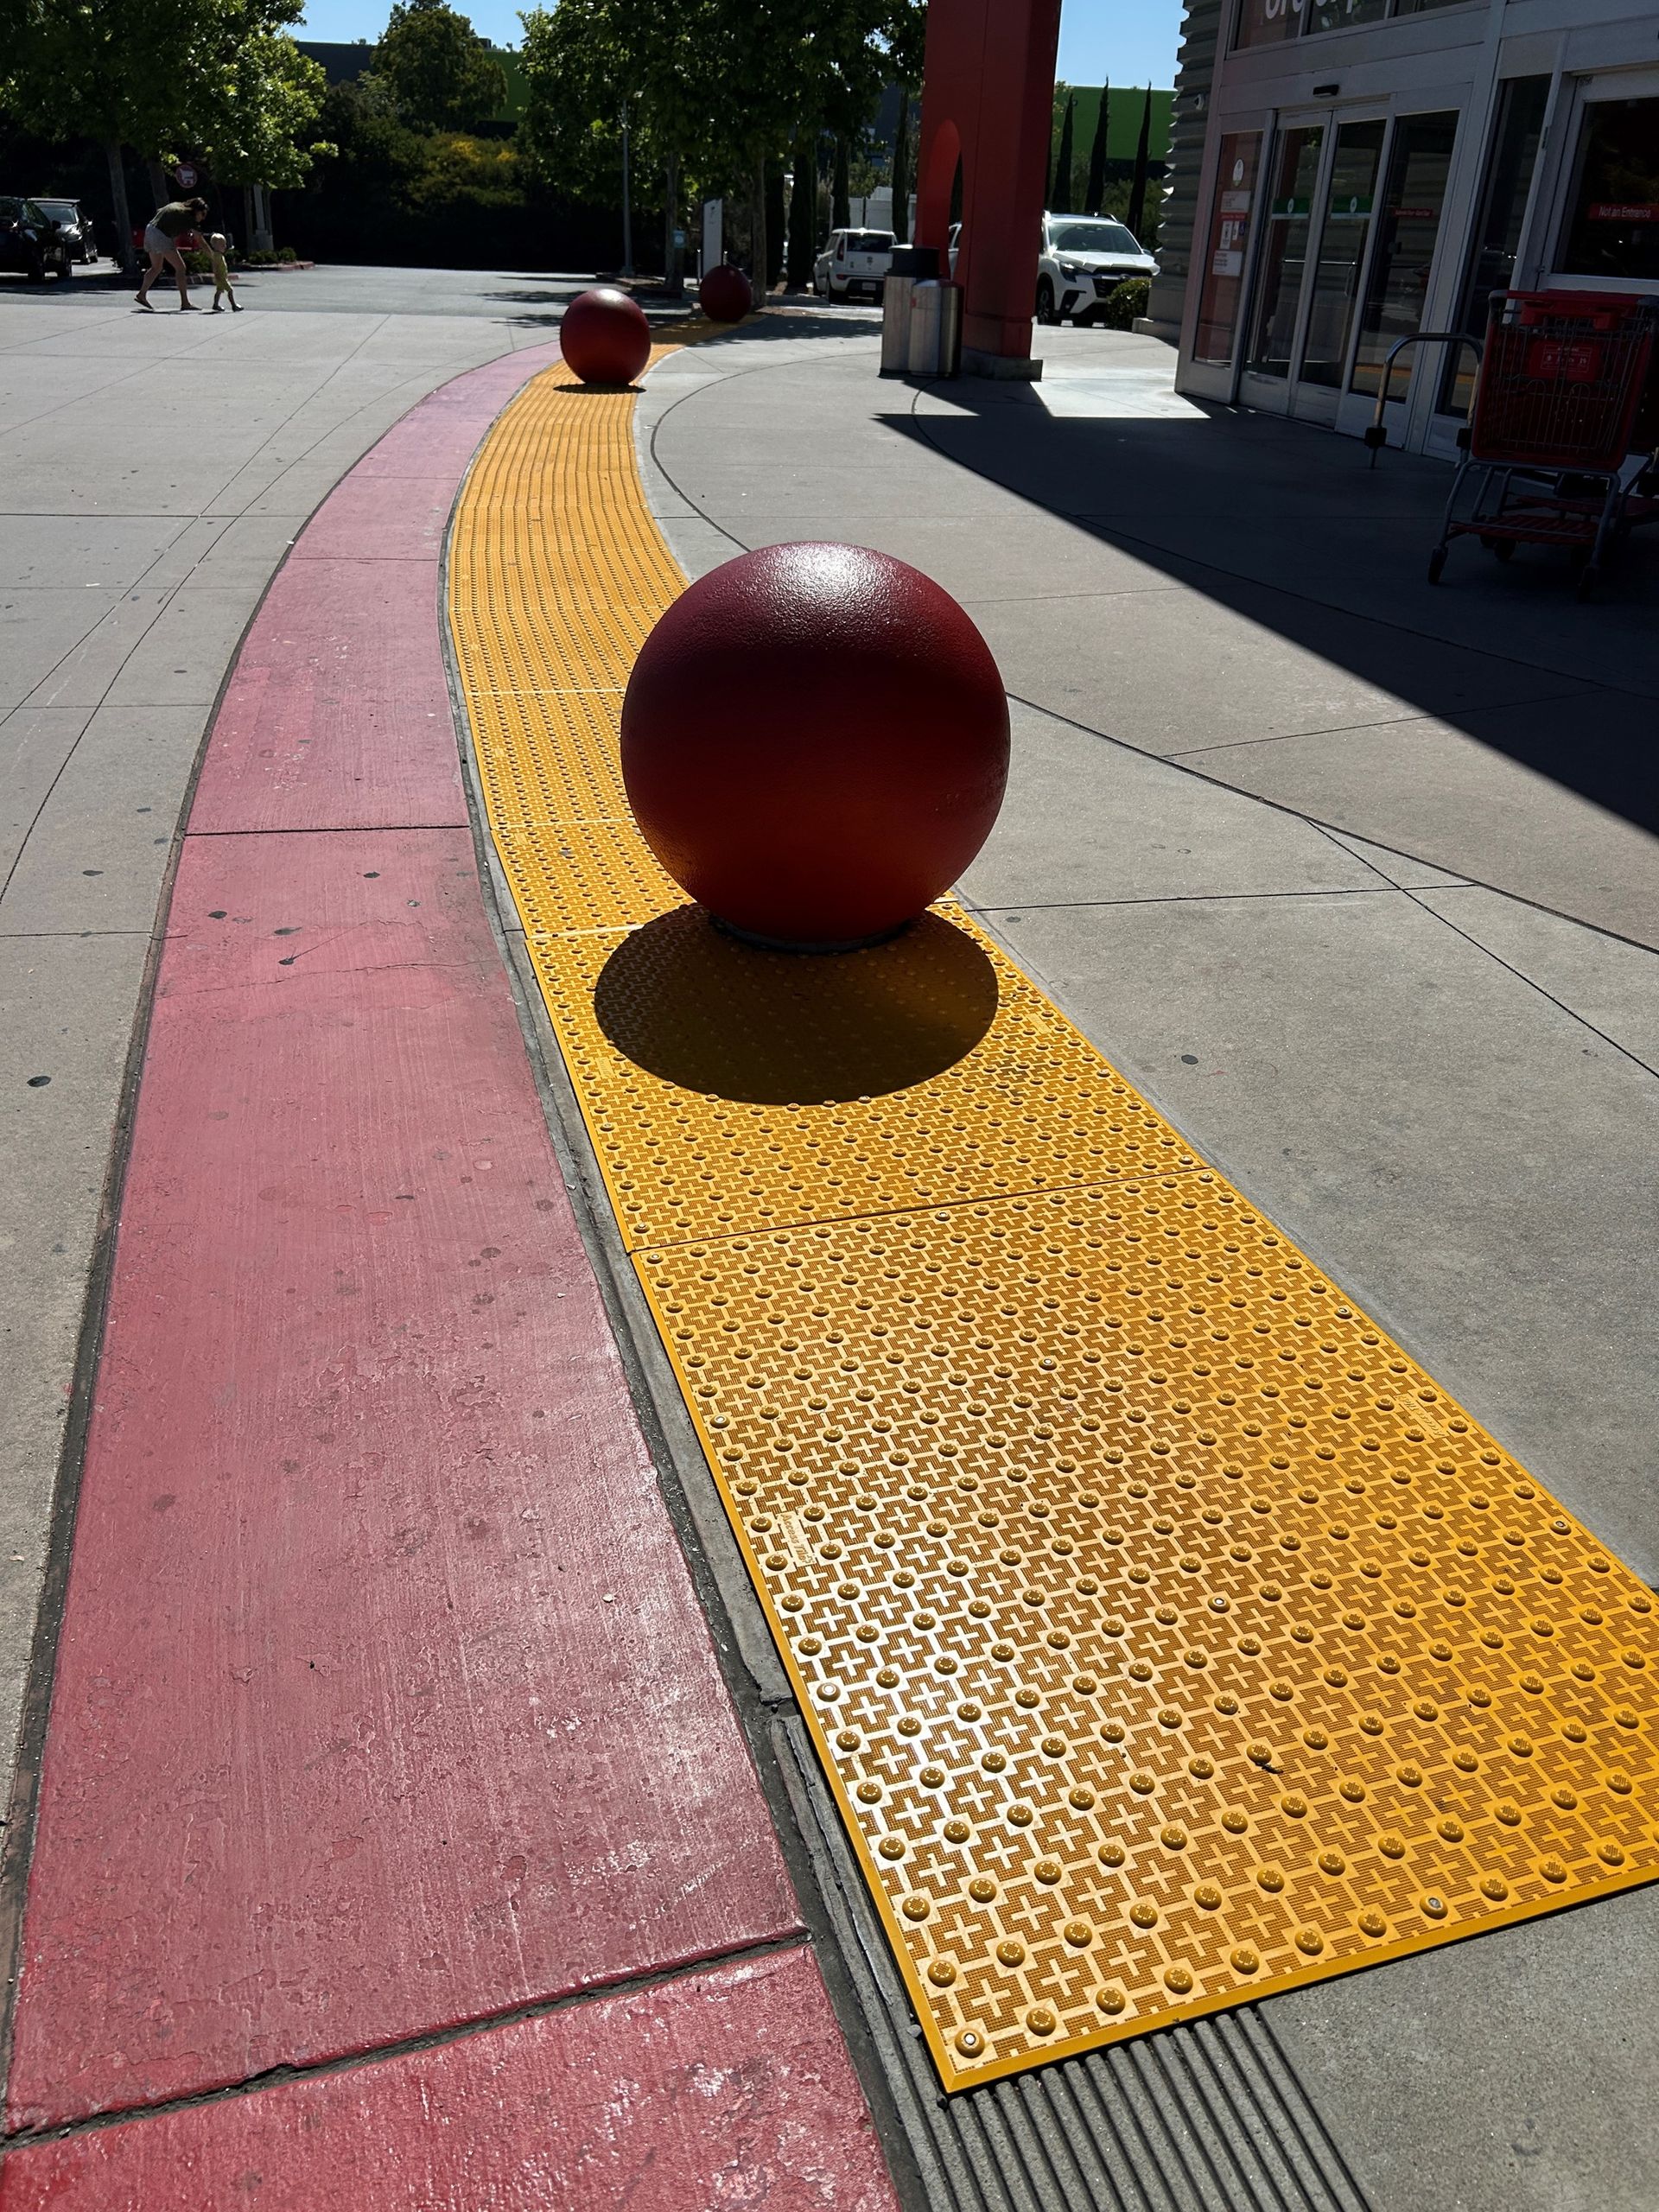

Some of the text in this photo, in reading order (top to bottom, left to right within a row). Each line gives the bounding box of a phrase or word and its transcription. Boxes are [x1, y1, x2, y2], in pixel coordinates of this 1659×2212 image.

[1599, 206, 1652, 219] Not an Entrance
[1416, 1412, 1445, 1436] Access
[780, 1514, 808, 1561] Access Tile
